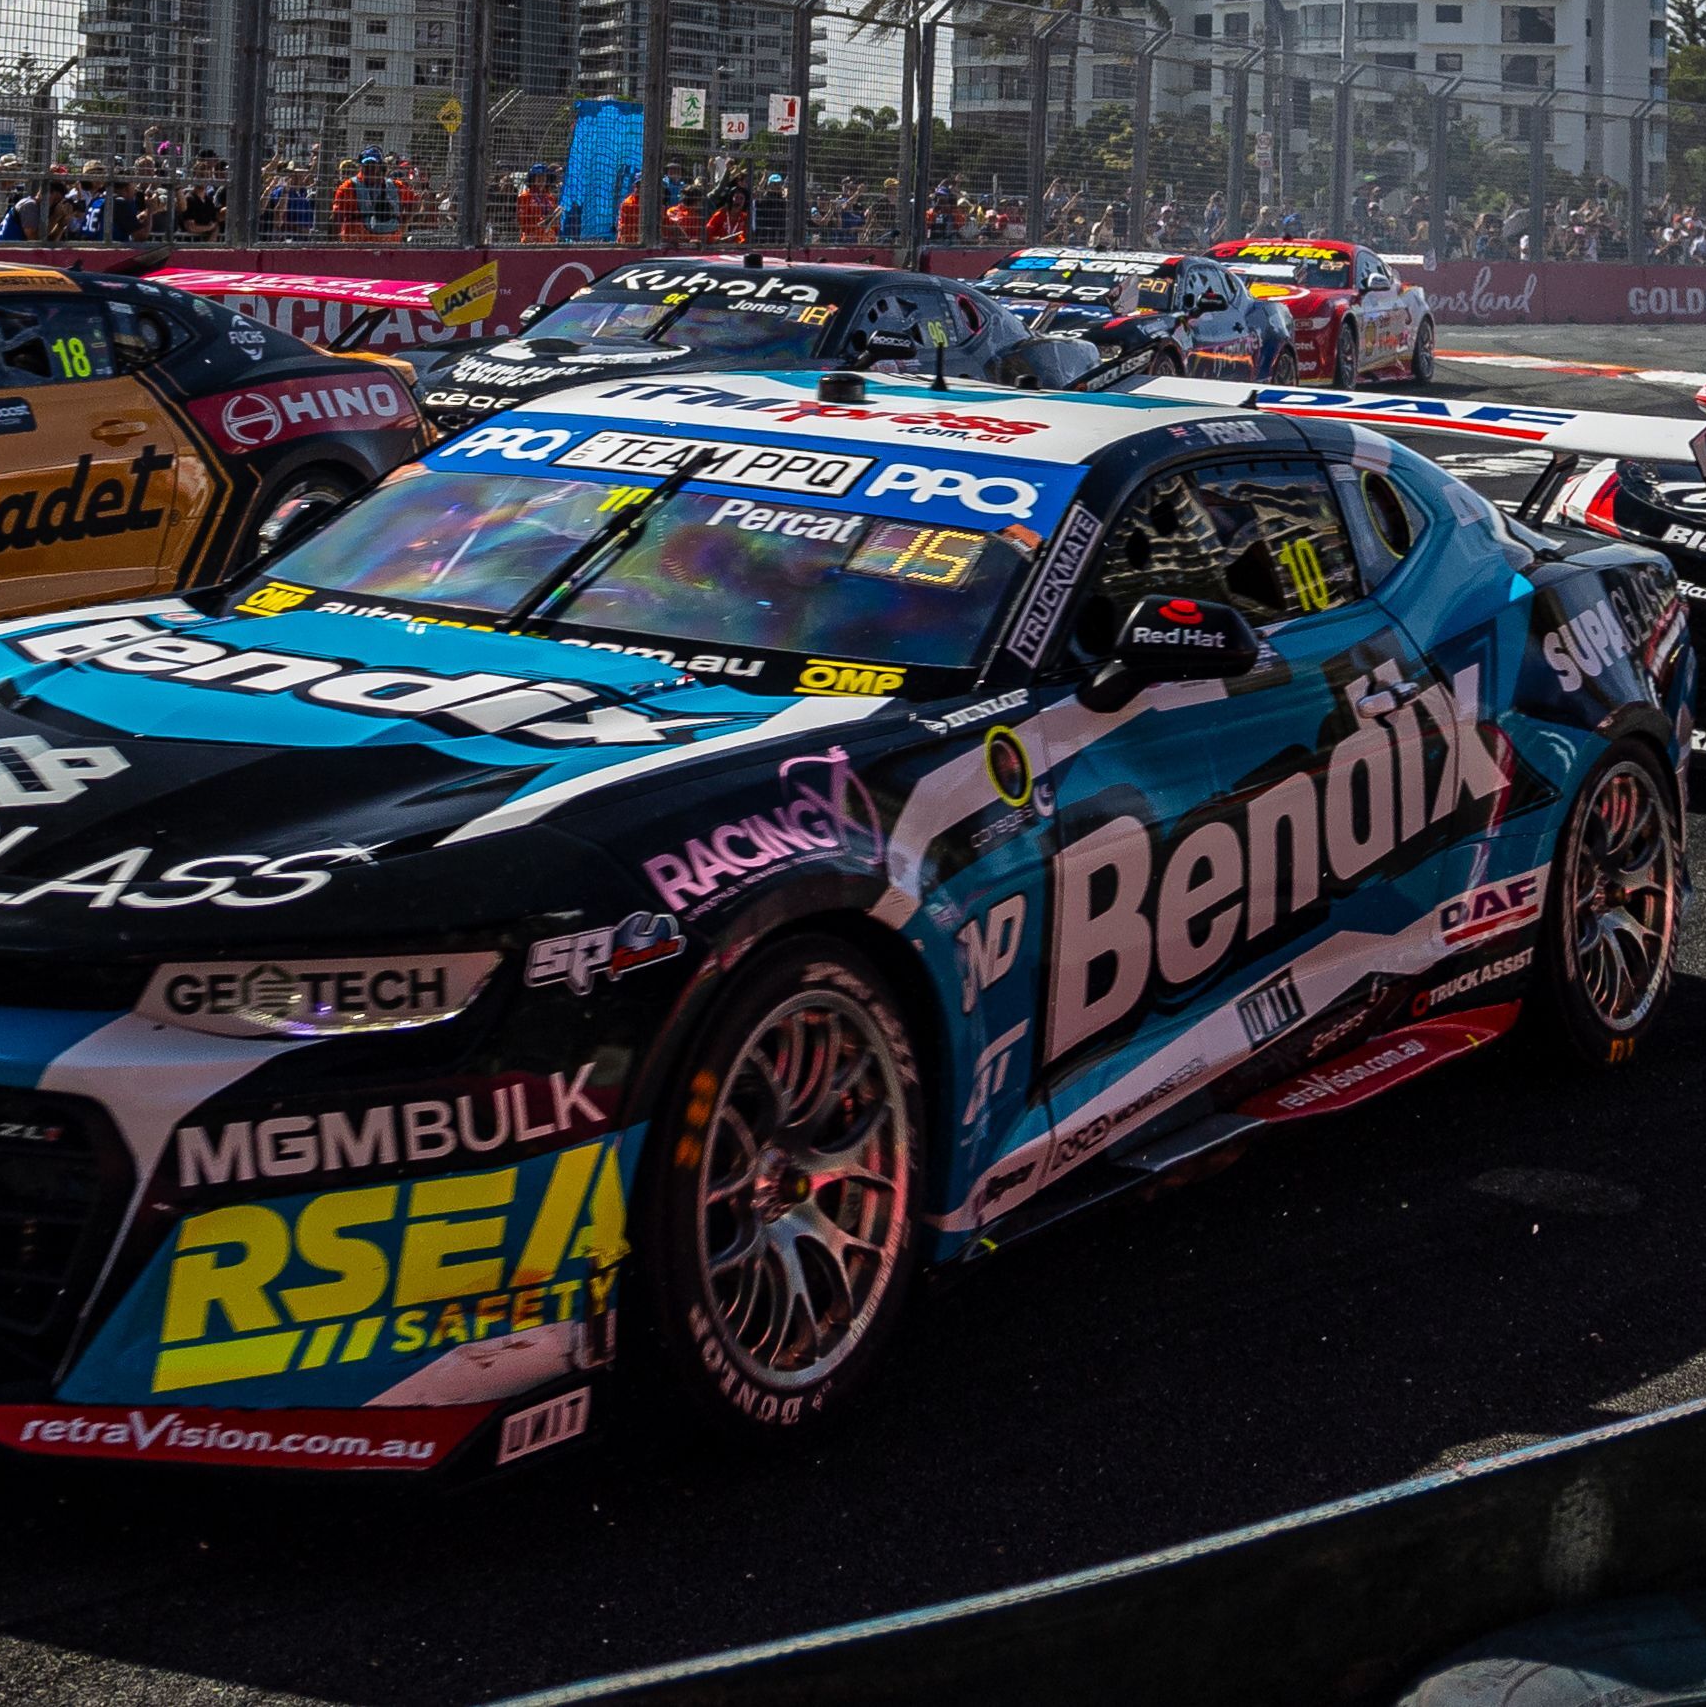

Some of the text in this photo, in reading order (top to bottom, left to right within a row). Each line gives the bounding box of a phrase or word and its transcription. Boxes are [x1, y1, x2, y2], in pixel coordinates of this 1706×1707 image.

[726, 121, 746, 134] 2.0
[611, 268, 821, 304] Kubota
[727, 298, 790, 315] Jones
[51, 337, 92, 379] 18
[278, 383, 400, 425] HINO
[1256, 389, 1578, 426] DAF
[438, 426, 573, 462] PPQ
[599, 437, 739, 475] TEAM
[735, 451, 852, 490] PPQ
[864, 462, 1039, 520] PPQ
[705, 497, 864, 544] Percat
[1014, 508, 1093, 658] TRUCKMATE
[1278, 537, 1329, 612] 10
[244, 587, 308, 612] OMP
[798, 665, 905, 695] OMP
[1131, 626, 1227, 649] Red Hat
[15, 618, 733, 743] Bendix
[939, 688, 1030, 730] DUNLOP
[1041, 657, 1513, 1066] Bendix
[1440, 875, 1538, 933] DAF
[176, 1061, 608, 1188] MGMBULK
[390, 1267, 619, 1353] SAFETY
[19, 1409, 437, 1461] retraVision.com.au
